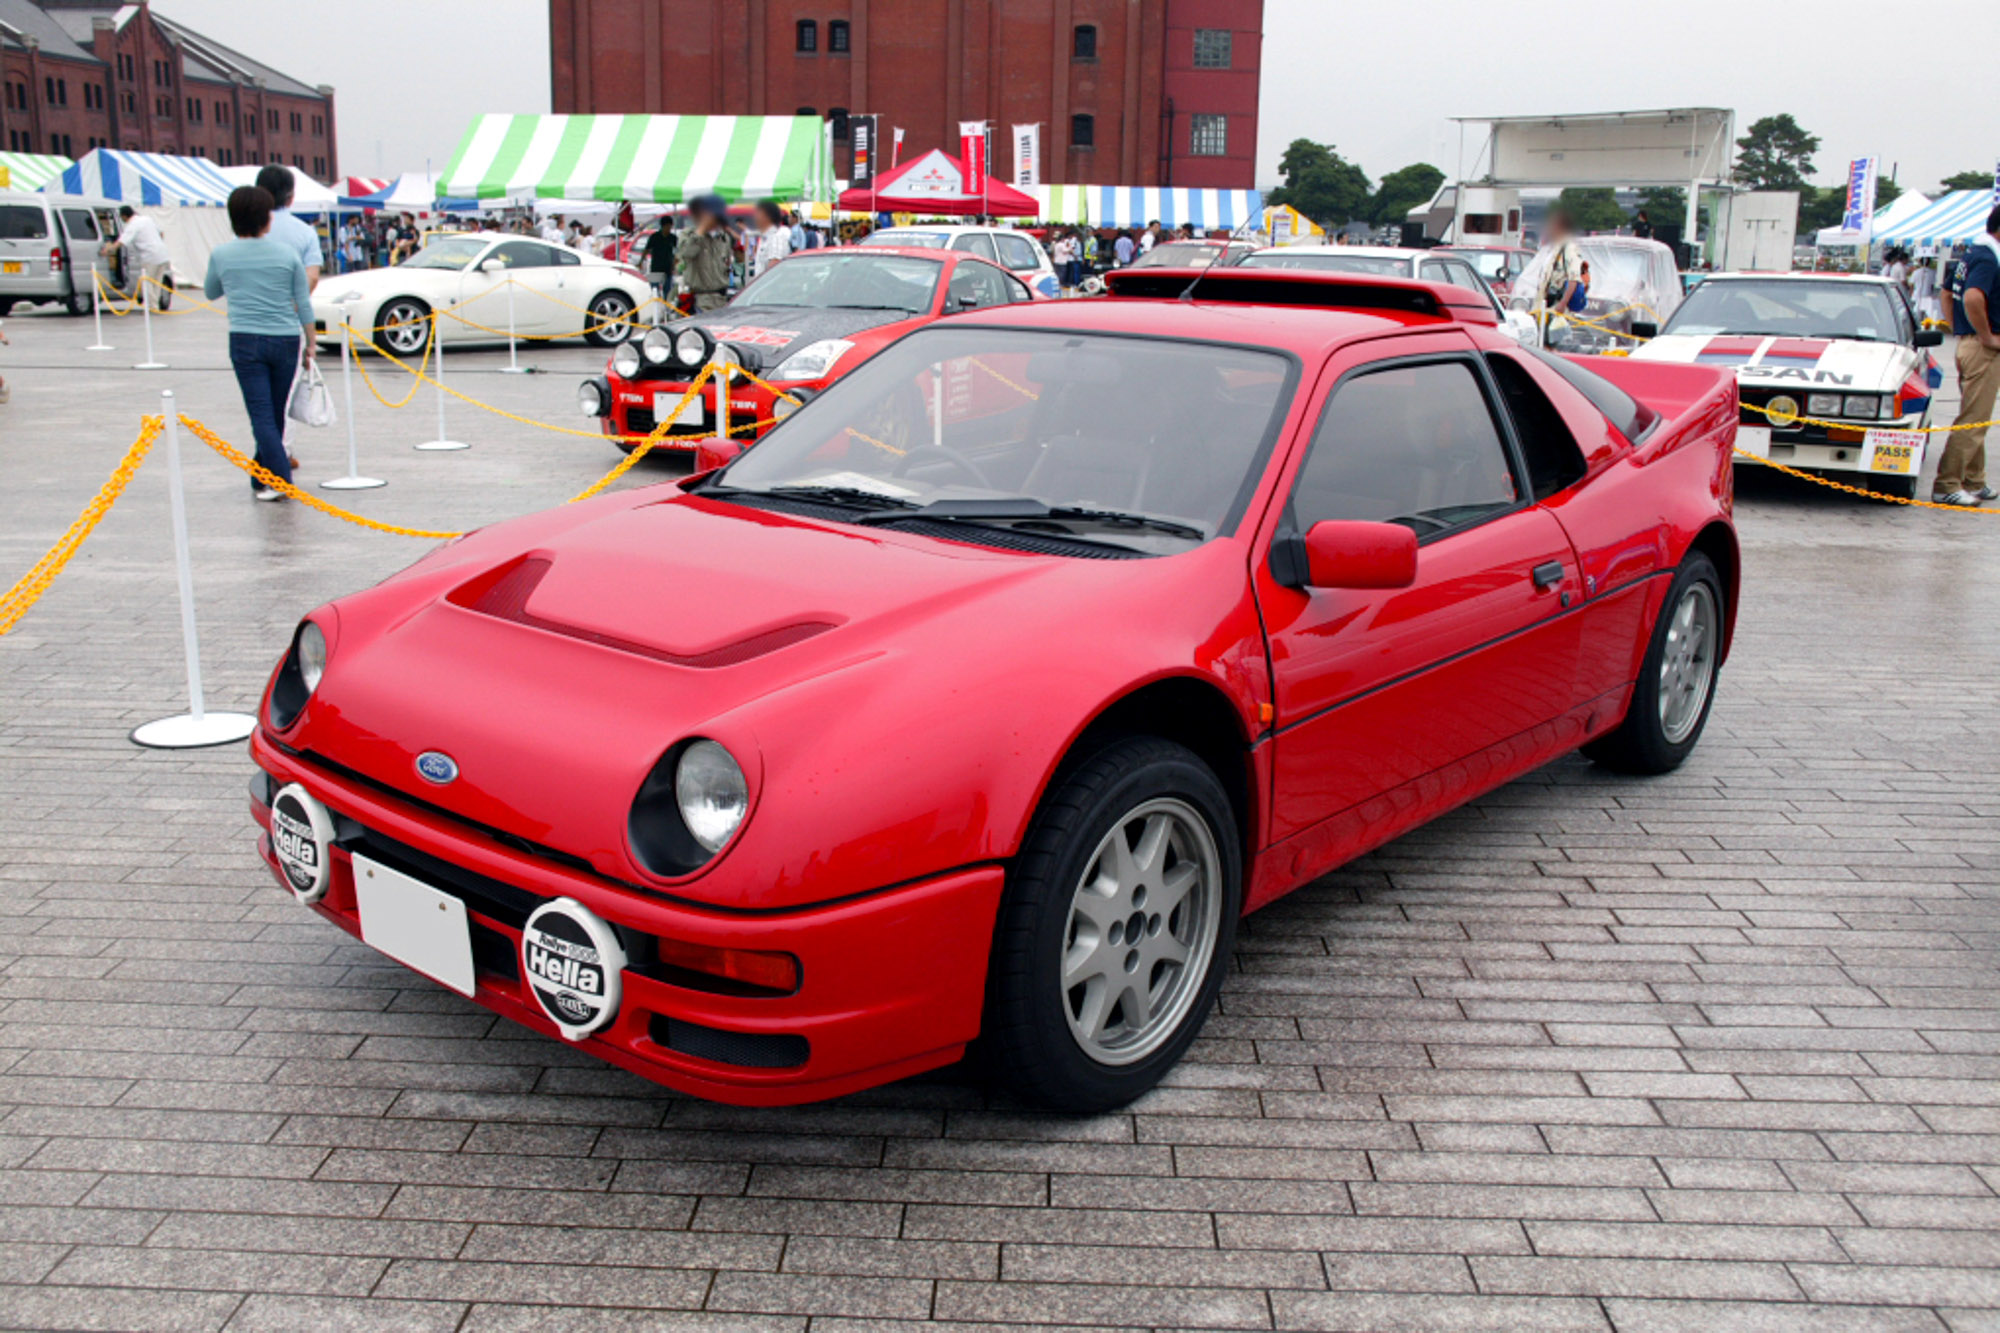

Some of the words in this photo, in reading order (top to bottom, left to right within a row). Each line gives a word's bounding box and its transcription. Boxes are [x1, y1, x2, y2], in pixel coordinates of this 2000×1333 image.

[1726, 365, 1853, 385] SAN
[1875, 446, 1911, 458] PASS
[275, 822, 315, 865] Hella
[530, 944, 599, 993] Hella
